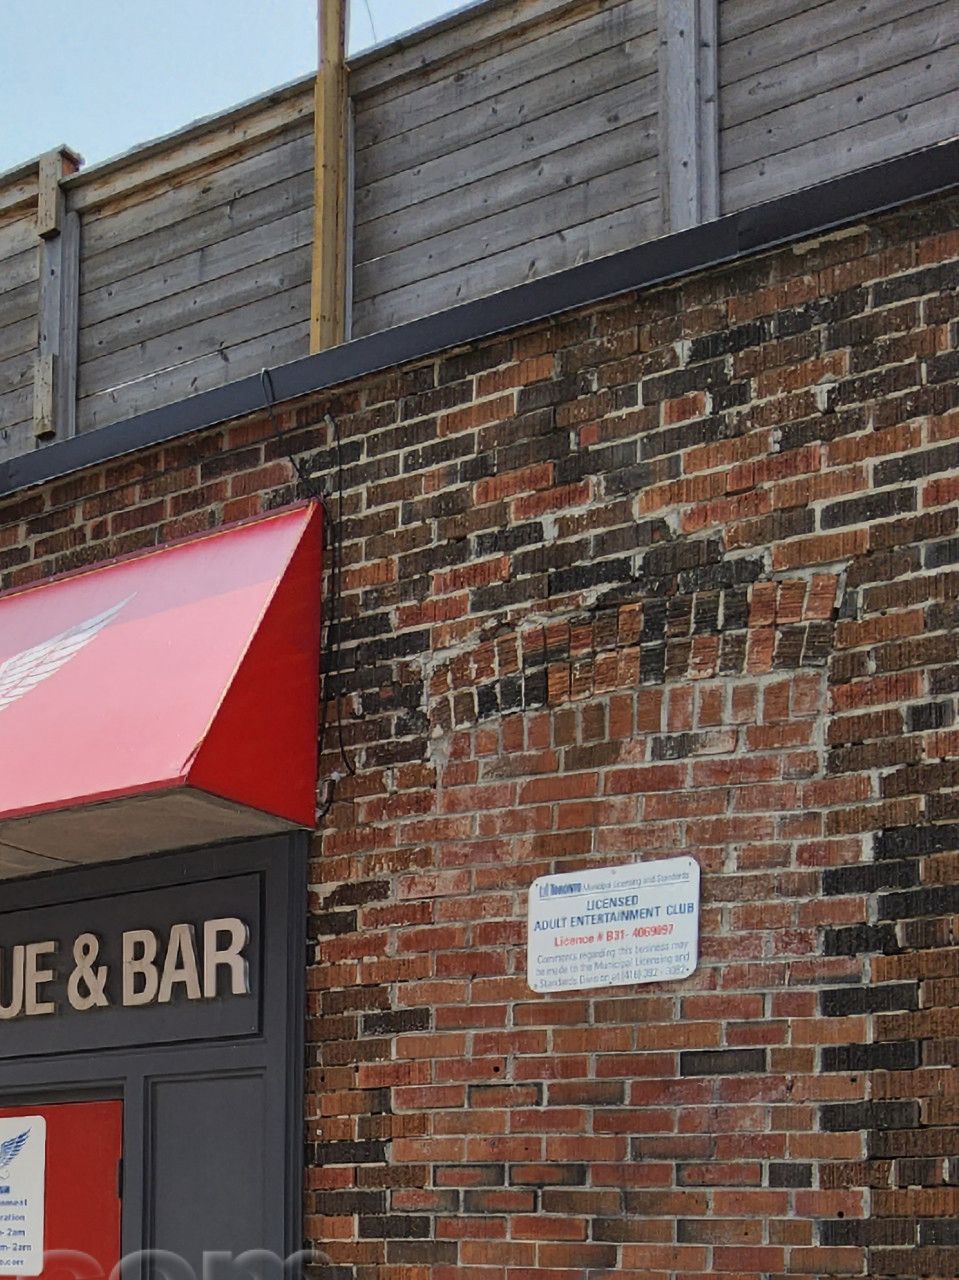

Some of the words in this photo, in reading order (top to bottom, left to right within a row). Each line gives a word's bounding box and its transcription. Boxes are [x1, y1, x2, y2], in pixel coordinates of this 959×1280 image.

[587, 895, 638, 910] LICENSED
[534, 917, 567, 931] ADULT
[570, 906, 661, 927] ENTERTAINMENT
[666, 902, 694, 915] CLUB
[554, 935, 594, 947] Licence
[68, 932, 108, 1011] &
[122, 917, 249, 1006] BAR
[7, 1228, 25, 1236] 2am
[12, 1243, 32, 1251] 2am
